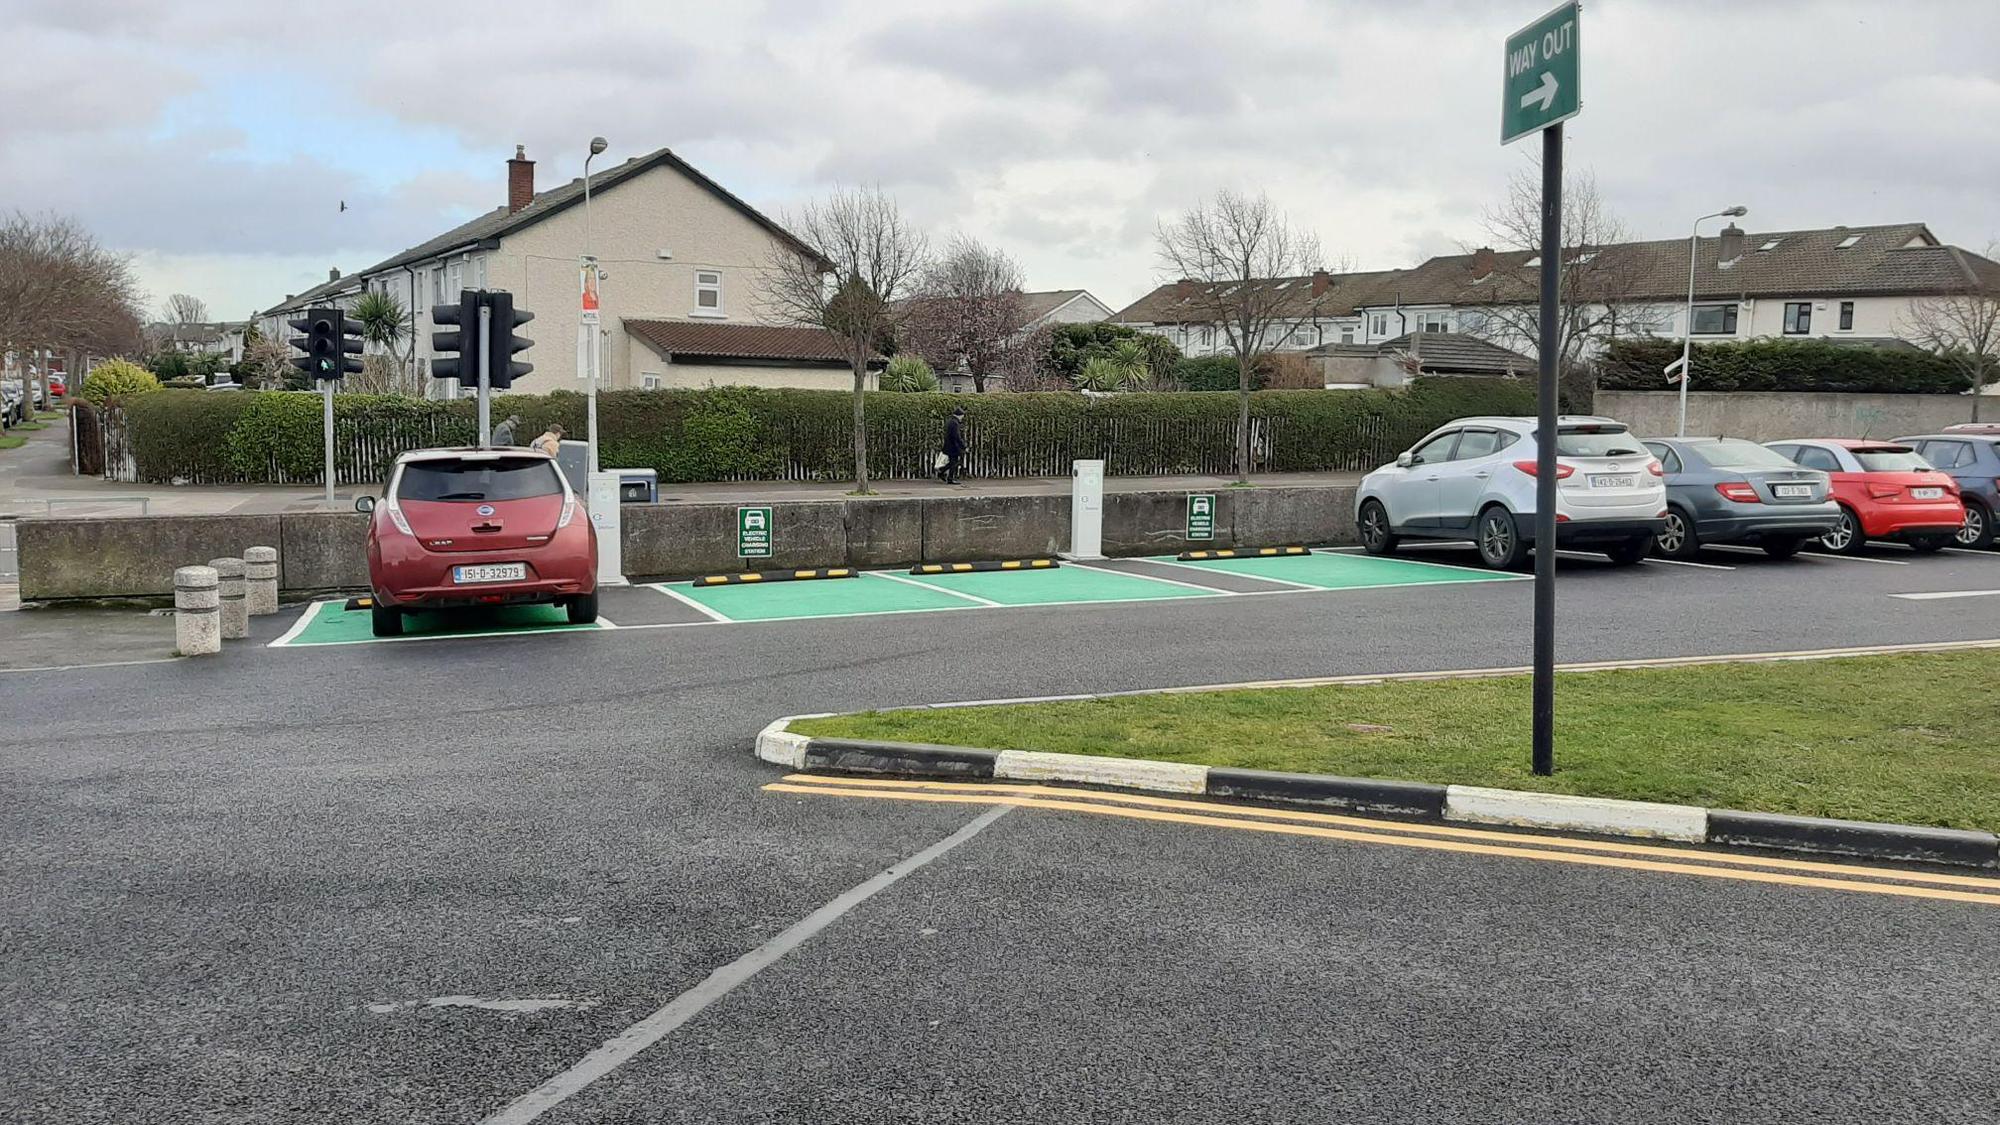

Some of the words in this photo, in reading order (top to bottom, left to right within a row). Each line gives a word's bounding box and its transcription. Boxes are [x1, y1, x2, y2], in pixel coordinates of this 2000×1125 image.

[1509, 40, 1537, 78] WAY
[1542, 21, 1573, 60] OUT
[464, 567, 519, 579] 151-D-32979
